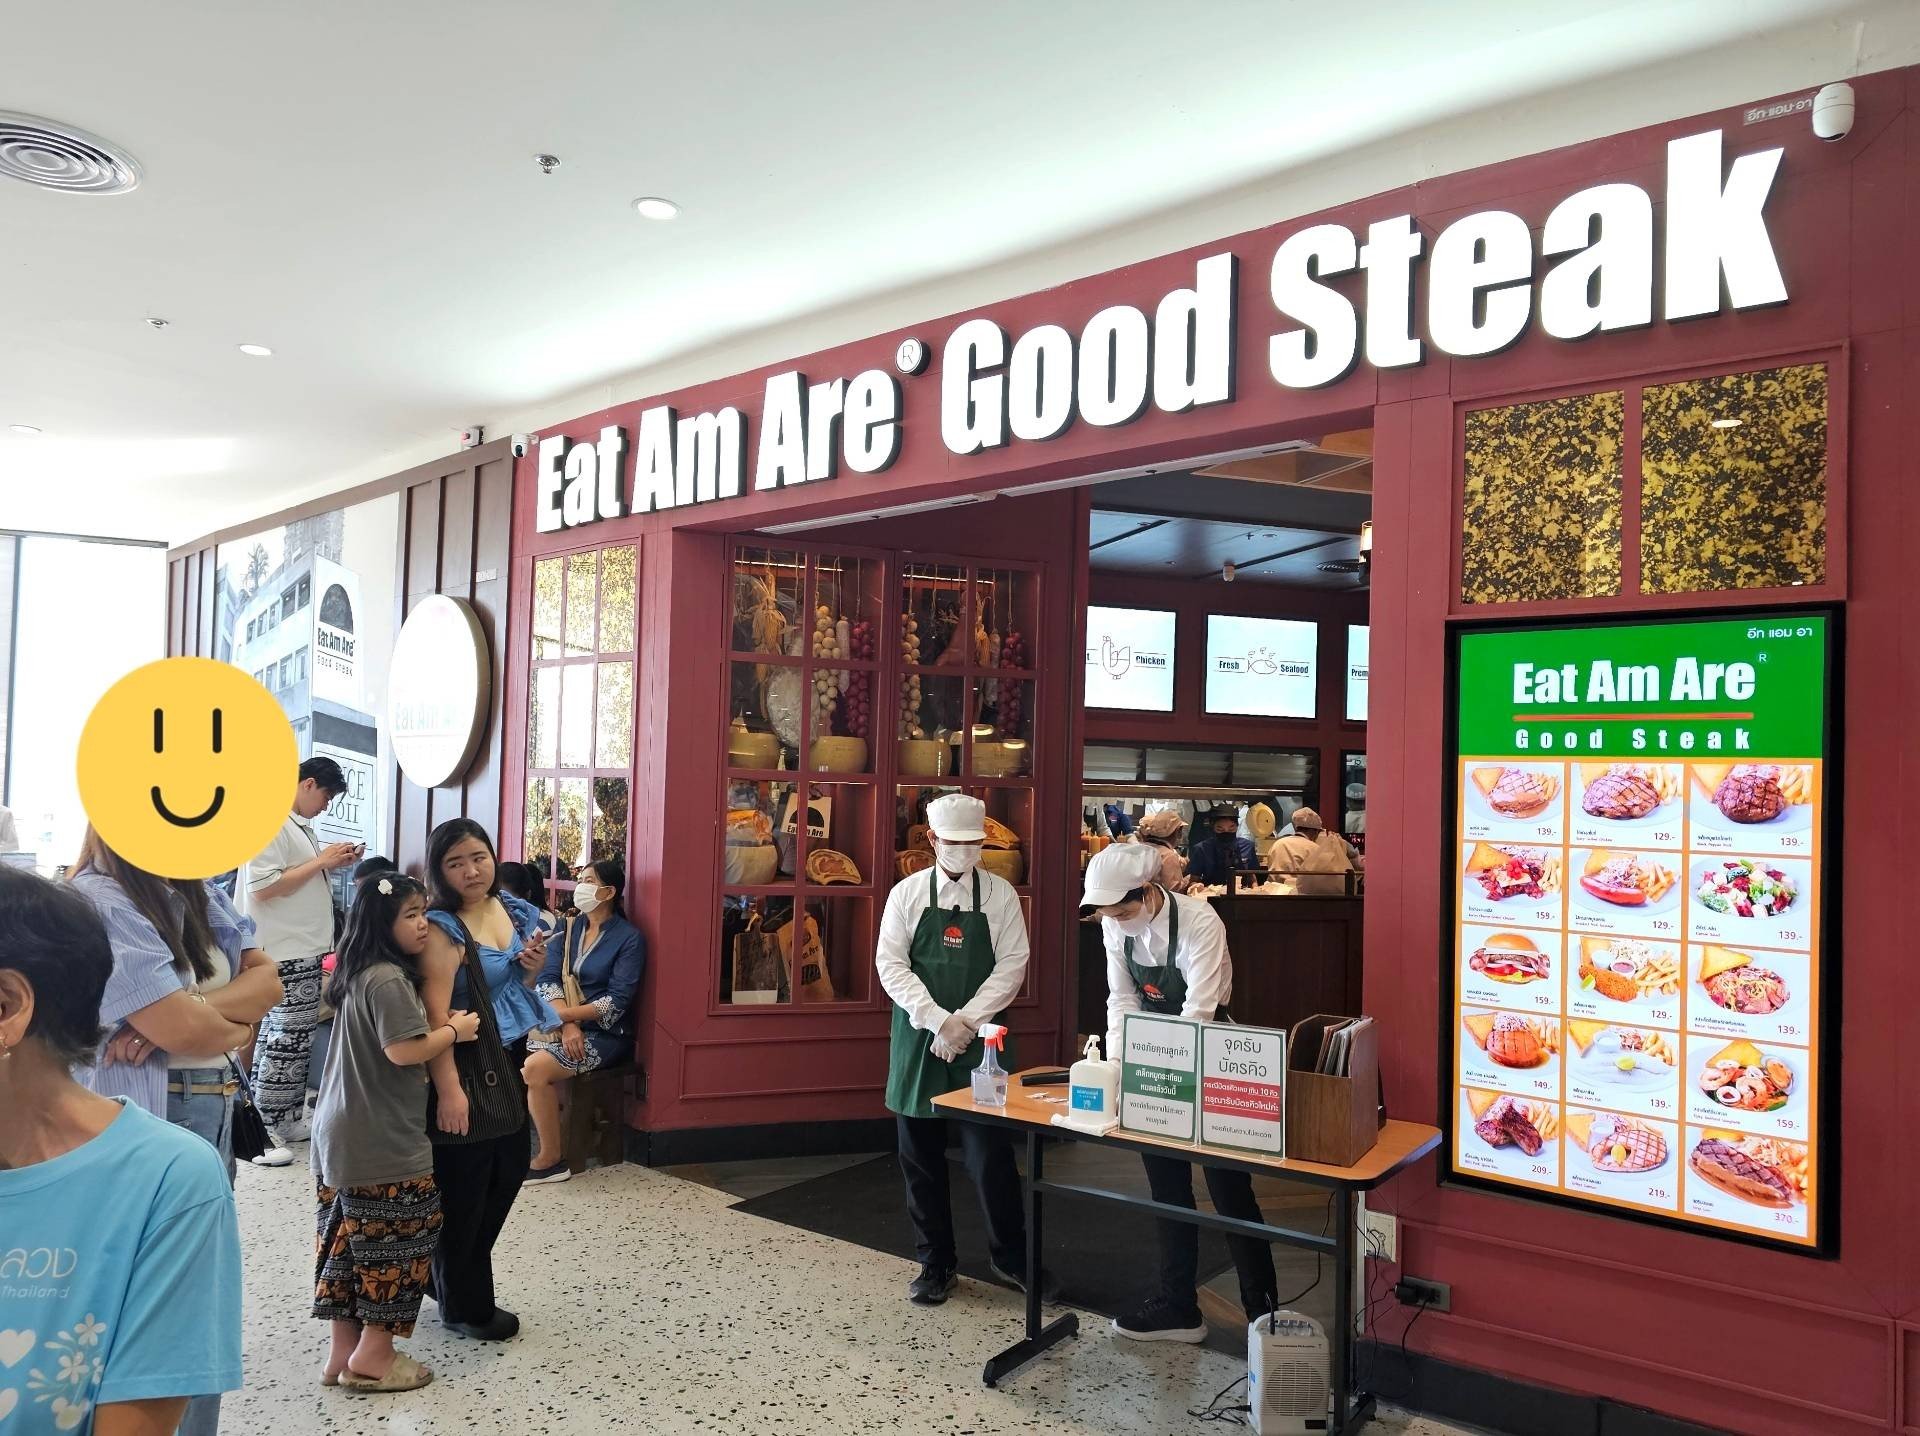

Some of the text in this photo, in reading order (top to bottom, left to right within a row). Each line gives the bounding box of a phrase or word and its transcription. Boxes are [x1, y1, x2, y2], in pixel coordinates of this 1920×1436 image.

[536, 425, 627, 533] Eat
[632, 405, 747, 514] Am
[755, 370, 902, 491] Are
[942, 252, 1237, 455] Good
[1270, 130, 1789, 388] Steak
[1769, 628, 1792, 638] แอม
[1796, 627, 1813, 637] อา
[1135, 655, 1166, 666] Chicken
[1219, 660, 1309, 674] Fresh Seafood
[1513, 662, 1578, 703] Eat
[1586, 660, 1660, 702] Am
[1670, 657, 1756, 701] Are
[1515, 727, 1750, 750] Good Steak
[1224, 1037, 1261, 1055] จุดรับ
[1219, 1057, 1267, 1077] บัตรคิว
[1260, 1087, 1269, 1096] 10
[1, 1285, 72, 1299] Thailand
